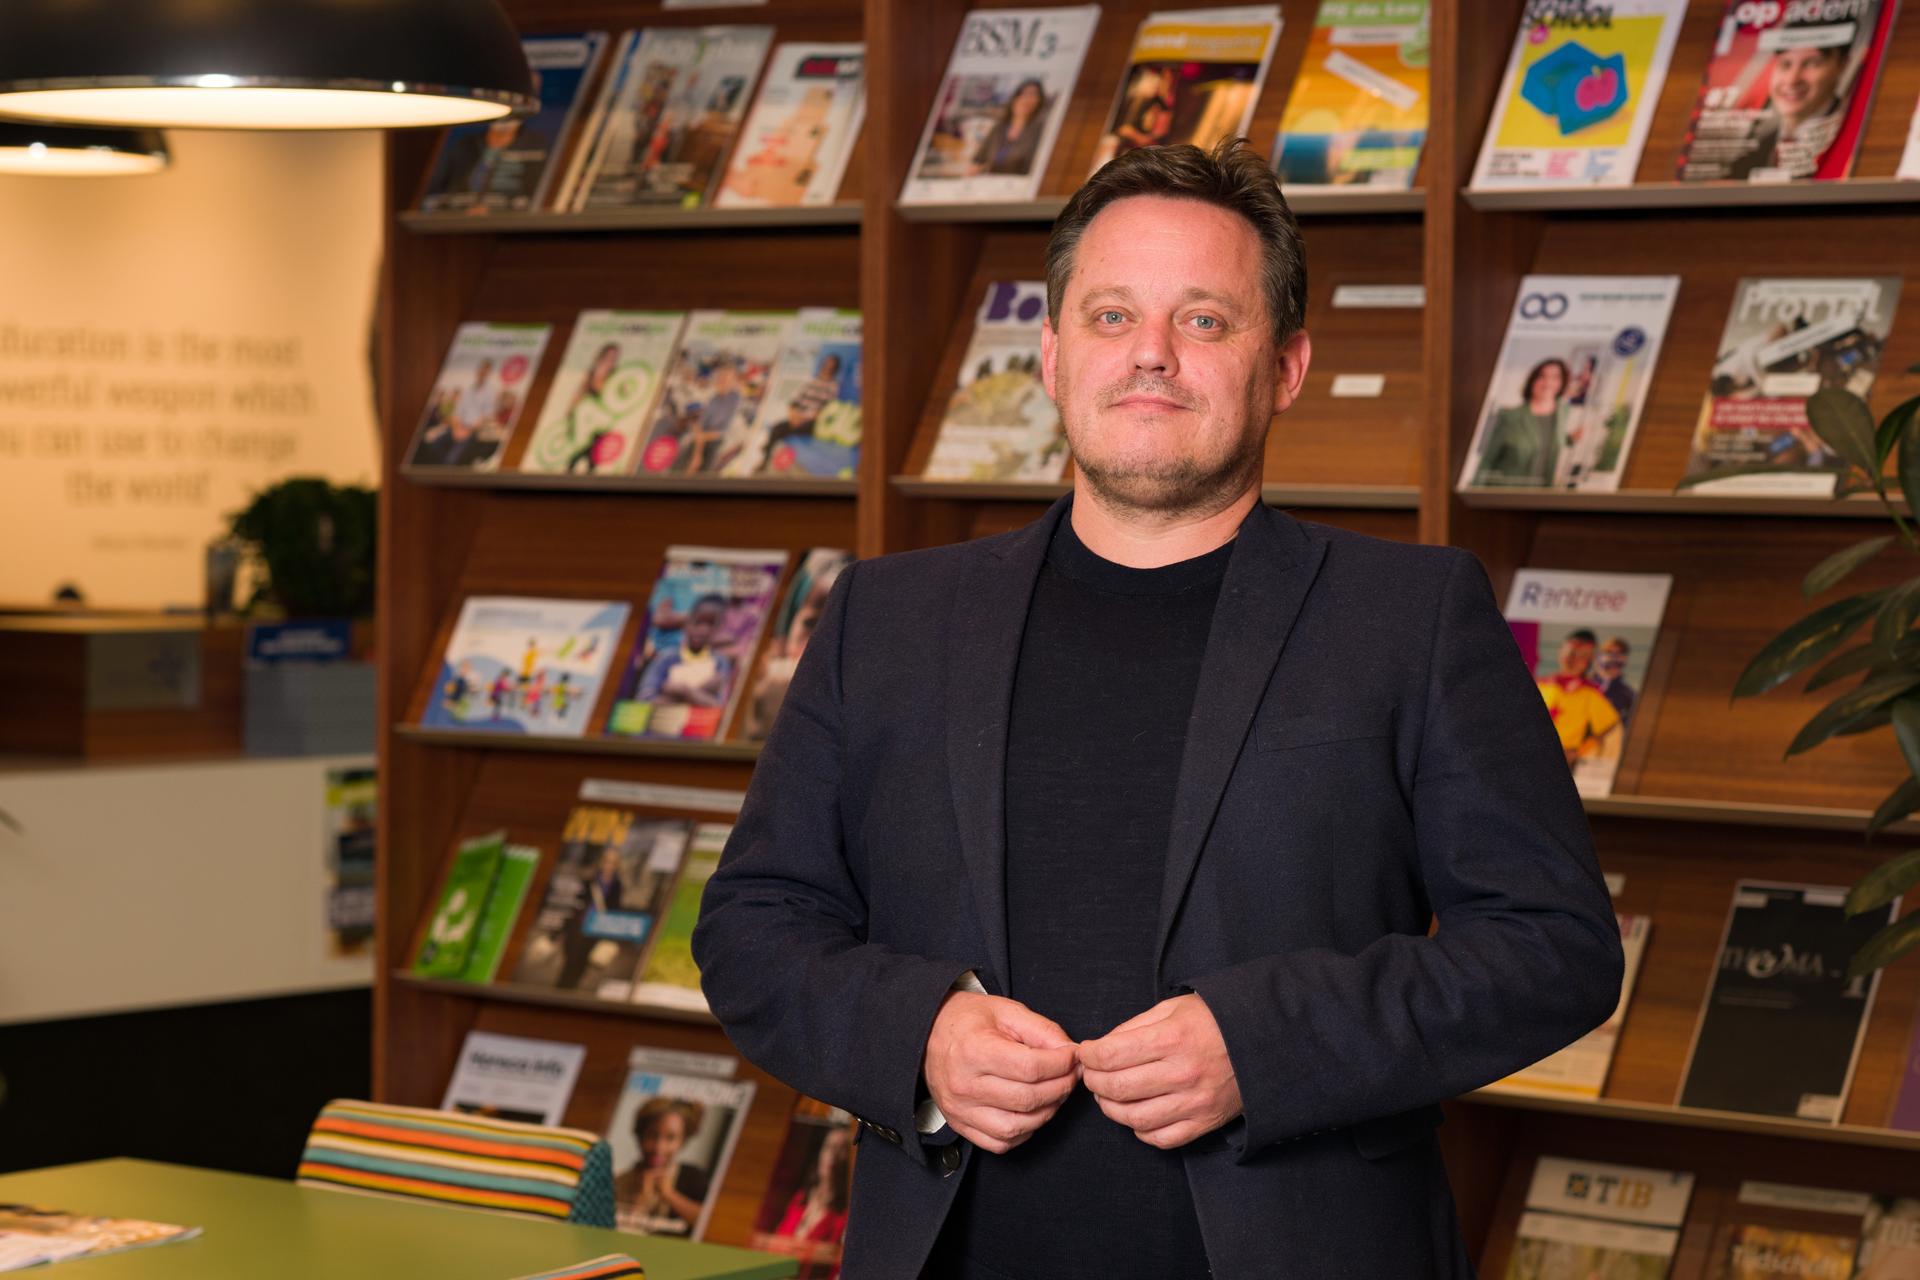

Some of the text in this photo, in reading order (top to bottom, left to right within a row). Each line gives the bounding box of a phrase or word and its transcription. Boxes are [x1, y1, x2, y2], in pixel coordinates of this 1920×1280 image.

[1736, 0, 1778, 27] op
[175, 331, 218, 365] the
[230, 336, 300, 368] most
[107, 382, 219, 416] weapon
[231, 379, 315, 414] which
[100, 430, 147, 456] use
[158, 426, 186, 456] to
[195, 427, 298, 463] change
[67, 471, 116, 504] the
[1596, 1175, 1655, 1209] TIB
